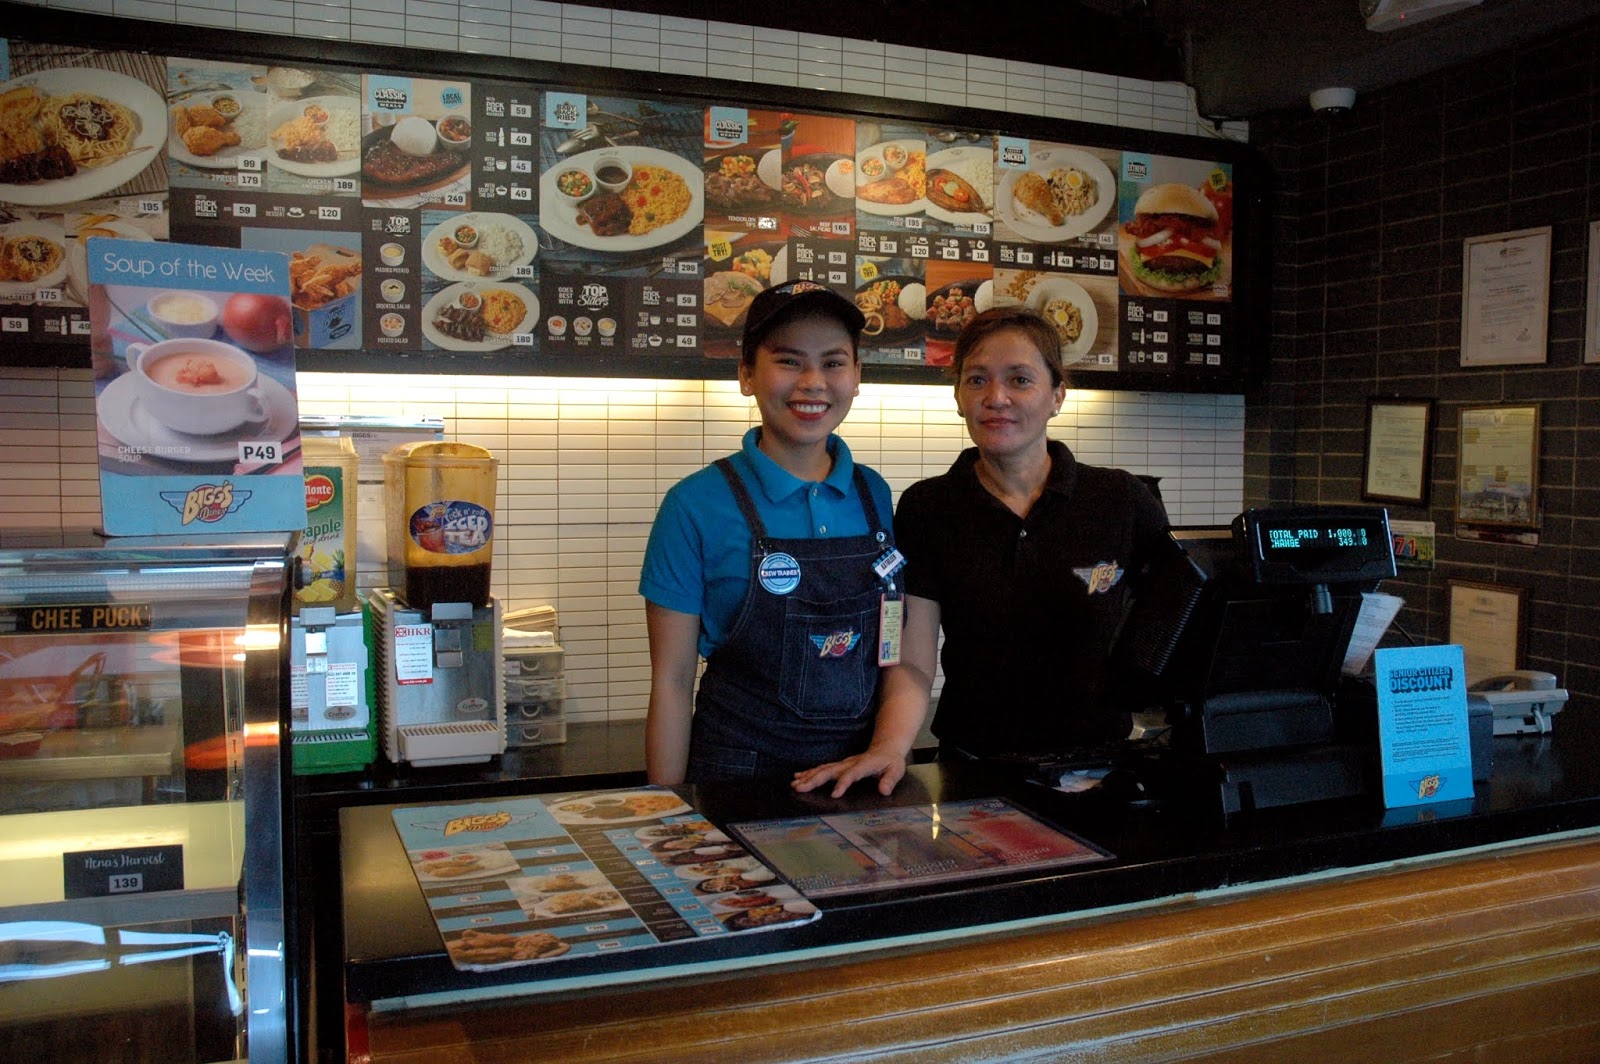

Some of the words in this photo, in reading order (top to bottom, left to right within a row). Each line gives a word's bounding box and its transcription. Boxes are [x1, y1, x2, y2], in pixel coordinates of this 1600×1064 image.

[374, 88, 407, 101] CLASSIC
[442, 93, 462, 101] LOCAL
[516, 107, 527, 115] 59
[243, 159, 256, 168] 99
[241, 176, 259, 185] 179
[337, 181, 353, 190] 189
[515, 190, 527, 198] 49
[448, 195, 463, 203] 249
[142, 202, 159, 211] 195
[239, 206, 251, 214] 59
[321, 209, 338, 217] 120
[389, 216, 410, 225] TOP
[907, 219, 920, 227] 195
[976, 225, 988, 233] 155
[712, 242, 727, 250] MUST
[713, 249, 728, 257] TRY!
[104, 253, 155, 278] Soup
[160, 257, 180, 276] of
[187, 260, 217, 279] the
[222, 261, 276, 283] Week
[681, 264, 695, 272] 299
[40, 291, 57, 299] 175
[583, 285, 607, 296] TOP
[682, 296, 692, 304] 59
[9, 320, 22, 329] 59
[681, 337, 692, 345] 49
[118, 446, 153, 454] CHEESE
[154, 446, 191, 454] BURGER
[243, 446, 276, 460] P49
[118, 455, 142, 463] SOUP
[471, 508, 486, 516] roll
[444, 515, 489, 531] ICED
[1269, 530, 1295, 539] TOTAL
[1297, 529, 1319, 539] PAID
[1328, 528, 1366, 539] 1,000.0
[445, 530, 486, 547] TEA
[1338, 537, 1368, 547] 349.0
[1391, 537, 1417, 557] 71
[31, 608, 82, 630] CHEE
[92, 605, 142, 628] PUCK
[407, 627, 431, 636] HKR
[1389, 668, 1417, 679] SENIOR
[1418, 666, 1453, 677] CITIZEN
[1389, 675, 1453, 693] DISCOUNT
[120, 851, 166, 868] Harvest
[113, 877, 138, 889] 139
